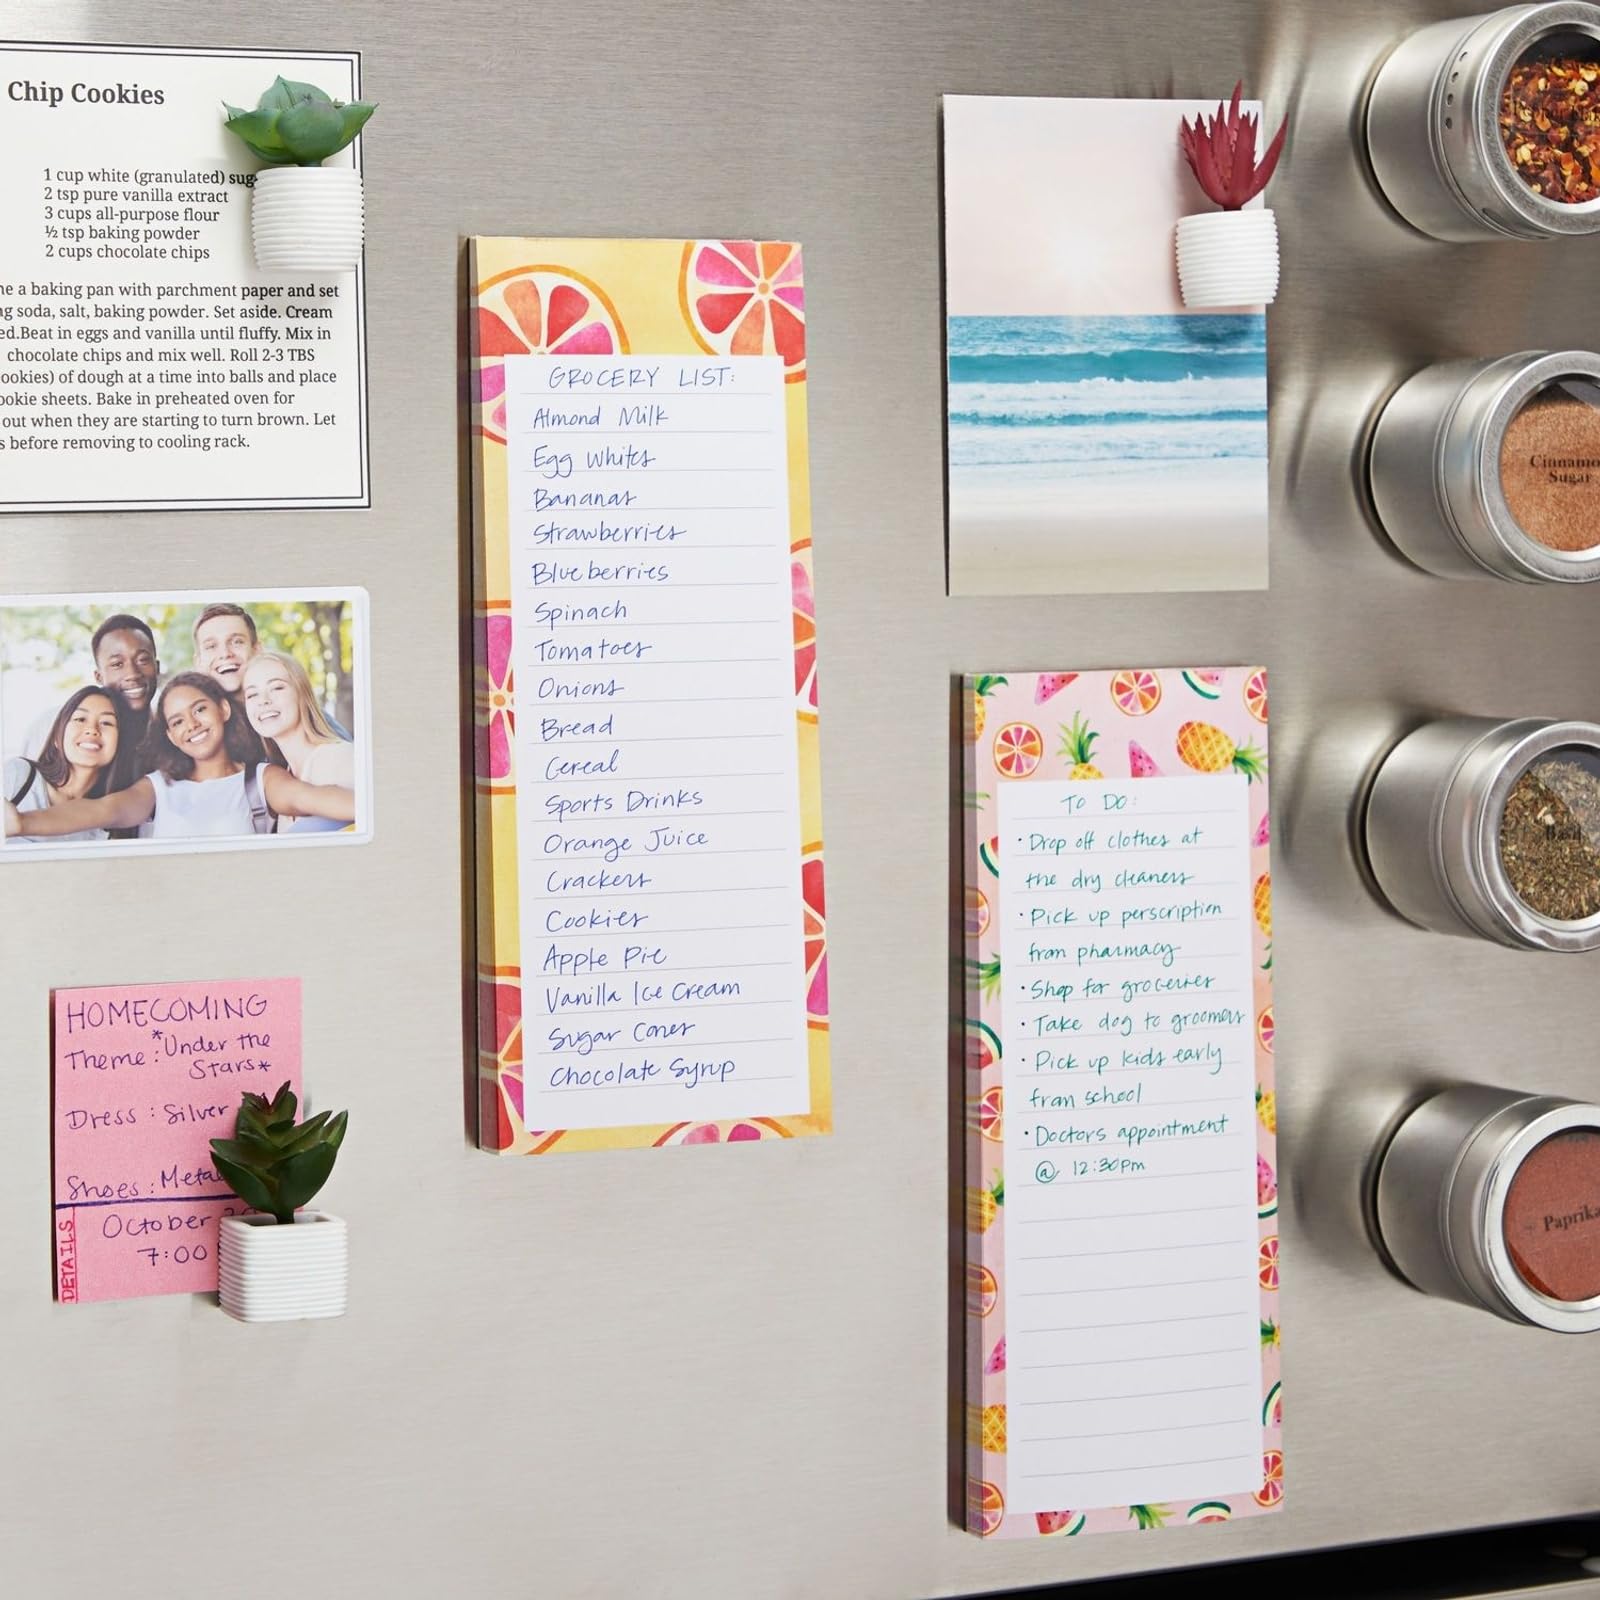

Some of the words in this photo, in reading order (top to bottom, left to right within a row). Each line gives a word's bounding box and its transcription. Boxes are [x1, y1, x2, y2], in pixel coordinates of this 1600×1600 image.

[8, 81, 63, 107] Chip
[71, 83, 164, 104] Cookies
[57, 171, 83, 185] cup
[88, 168, 129, 182] white
[134, 169, 225, 187] (granulated)
[229, 173, 257, 188] sug
[57, 189, 79, 204] tsp
[83, 190, 118, 204] pure
[123, 188, 173, 202] vanilla
[178, 191, 229, 203] extract
[58, 209, 91, 224] cups
[96, 206, 179, 224] all-purpose
[184, 208, 220, 221] flour
[62, 227, 84, 242] tsp
[89, 225, 140, 243] baking
[144, 226, 200, 243] powder
[59, 247, 92, 261] cups
[97, 244, 167, 258] chocolate
[171, 245, 209, 262] chips
[31, 282, 83, 299] baking
[87, 286, 114, 299] pan
[119, 282, 152, 296] with
[157, 283, 237, 300] parchment
[241, 287, 284, 300] paper
[288, 283, 315, 297] and
[319, 286, 339, 297] set
[17, 304, 55, 319] soda,
[60, 304, 90, 319] salt,
[94, 304, 144, 321] baking
[149, 305, 209, 321] powder.
[214, 305, 235, 318] Set
[240, 304, 281, 318] aside.
[286, 305, 332, 318] Cream
[77, 329, 108, 343] eggs
[113, 326, 141, 339] and
[145, 326, 195, 340] vanilla
[200, 326, 234, 340] until
[239, 326, 280, 343] fluffy.
[286, 327, 313, 340] Mix
[8, 348, 78, 361] chocolate
[83, 348, 121, 365] chips
[126, 348, 154, 361] and
[158, 348, 187, 361] mix
[191, 348, 225, 361] well.
[230, 348, 258, 361] Roll
[262, 348, 283, 361] 2-3
[287, 348, 315, 361] TBS
[78, 370, 123, 387] dough
[159, 370, 192, 383] time
[197, 370, 225, 383] into
[230, 369, 263, 383] balls
[268, 369, 295, 383] and
[299, 369, 336, 386] place
[548, 366, 660, 389] GROCERY
[679, 366, 735, 388] LIST:
[42, 392, 91, 405] sheets.
[96, 392, 132, 405] Bake
[156, 391, 230, 408] preheated
[234, 394, 268, 404] oven
[274, 391, 295, 404] for
[2, 416, 26, 427] out
[31, 414, 72, 427] when
[77, 414, 109, 430] they
[114, 417, 137, 427] are
[142, 413, 199, 430] starting
[203, 415, 217, 426] to
[222, 415, 253, 426] turn
[257, 412, 309, 425] brown.
[314, 413, 336, 425] Let
[533, 406, 601, 429] Almond
[618, 405, 669, 427] Milk
[10, 436, 58, 450] before
[63, 435, 135, 452] removing
[139, 437, 152, 448] to
[157, 434, 211, 451] cooling
[215, 434, 249, 447] rack.
[533, 445, 573, 479] Egg
[1549, 470, 1592, 485] Sugar
[533, 488, 637, 512] Bananas
[533, 521, 687, 545] Strawberries
[534, 599, 628, 631] Spinach
[534, 638, 652, 662] Tomatoes
[537, 677, 624, 699] Onions
[541, 714, 613, 742] Bread
[545, 749, 620, 781] Cereal
[544, 794, 613, 823] Sports
[626, 789, 703, 812] Drinks
[543, 833, 632, 863] Orange
[644, 826, 709, 852] Juice
[1029, 833, 1067, 856] Drop
[1075, 830, 1094, 850] off
[1108, 830, 1171, 848] clothes
[1181, 826, 1203, 844] at
[546, 869, 652, 893] Crackers
[1025, 871, 1057, 889] the
[1071, 868, 1101, 893] dry
[1114, 869, 1195, 887] cleaners
[545, 908, 649, 932] Cookies
[1031, 907, 1078, 927] Pick
[1089, 910, 1110, 928] up
[542, 944, 609, 976] Apple
[624, 945, 667, 969] Pie
[1077, 941, 1181, 967] pharmacy
[546, 981, 622, 1014] Vanilla
[634, 981, 663, 1006] Ice
[671, 981, 741, 1002] Cream
[1031, 979, 1074, 1003] Shop
[1082, 978, 1110, 996] for
[1121, 974, 1216, 1003] groceries
[67, 993, 267, 1034] HOMECOMING
[1033, 1014, 1083, 1037] Take
[1098, 1012, 1132, 1037] dog
[1144, 1012, 1160, 1029] to
[1171, 1008, 1246, 1034] groomers
[236, 1033, 271, 1048] the
[548, 1027, 621, 1055] Sugar
[633, 1021, 696, 1042] Cones
[1035, 1050, 1079, 1073] Pick
[1088, 1056, 1109, 1076] up
[1122, 1047, 1166, 1068] kids
[1172, 1042, 1222, 1075] early
[550, 1059, 661, 1087] Chocolate
[669, 1057, 735, 1089] Syrup
[1085, 1082, 1142, 1106] school
[163, 1104, 229, 1125] Silver
[1035, 1125, 1106, 1148] Doctors
[1117, 1114, 1229, 1148] appointment
[102, 1214, 212, 1238] October
[59, 1219, 75, 1302] DETAILS
[137, 1245, 208, 1266] 7:00
